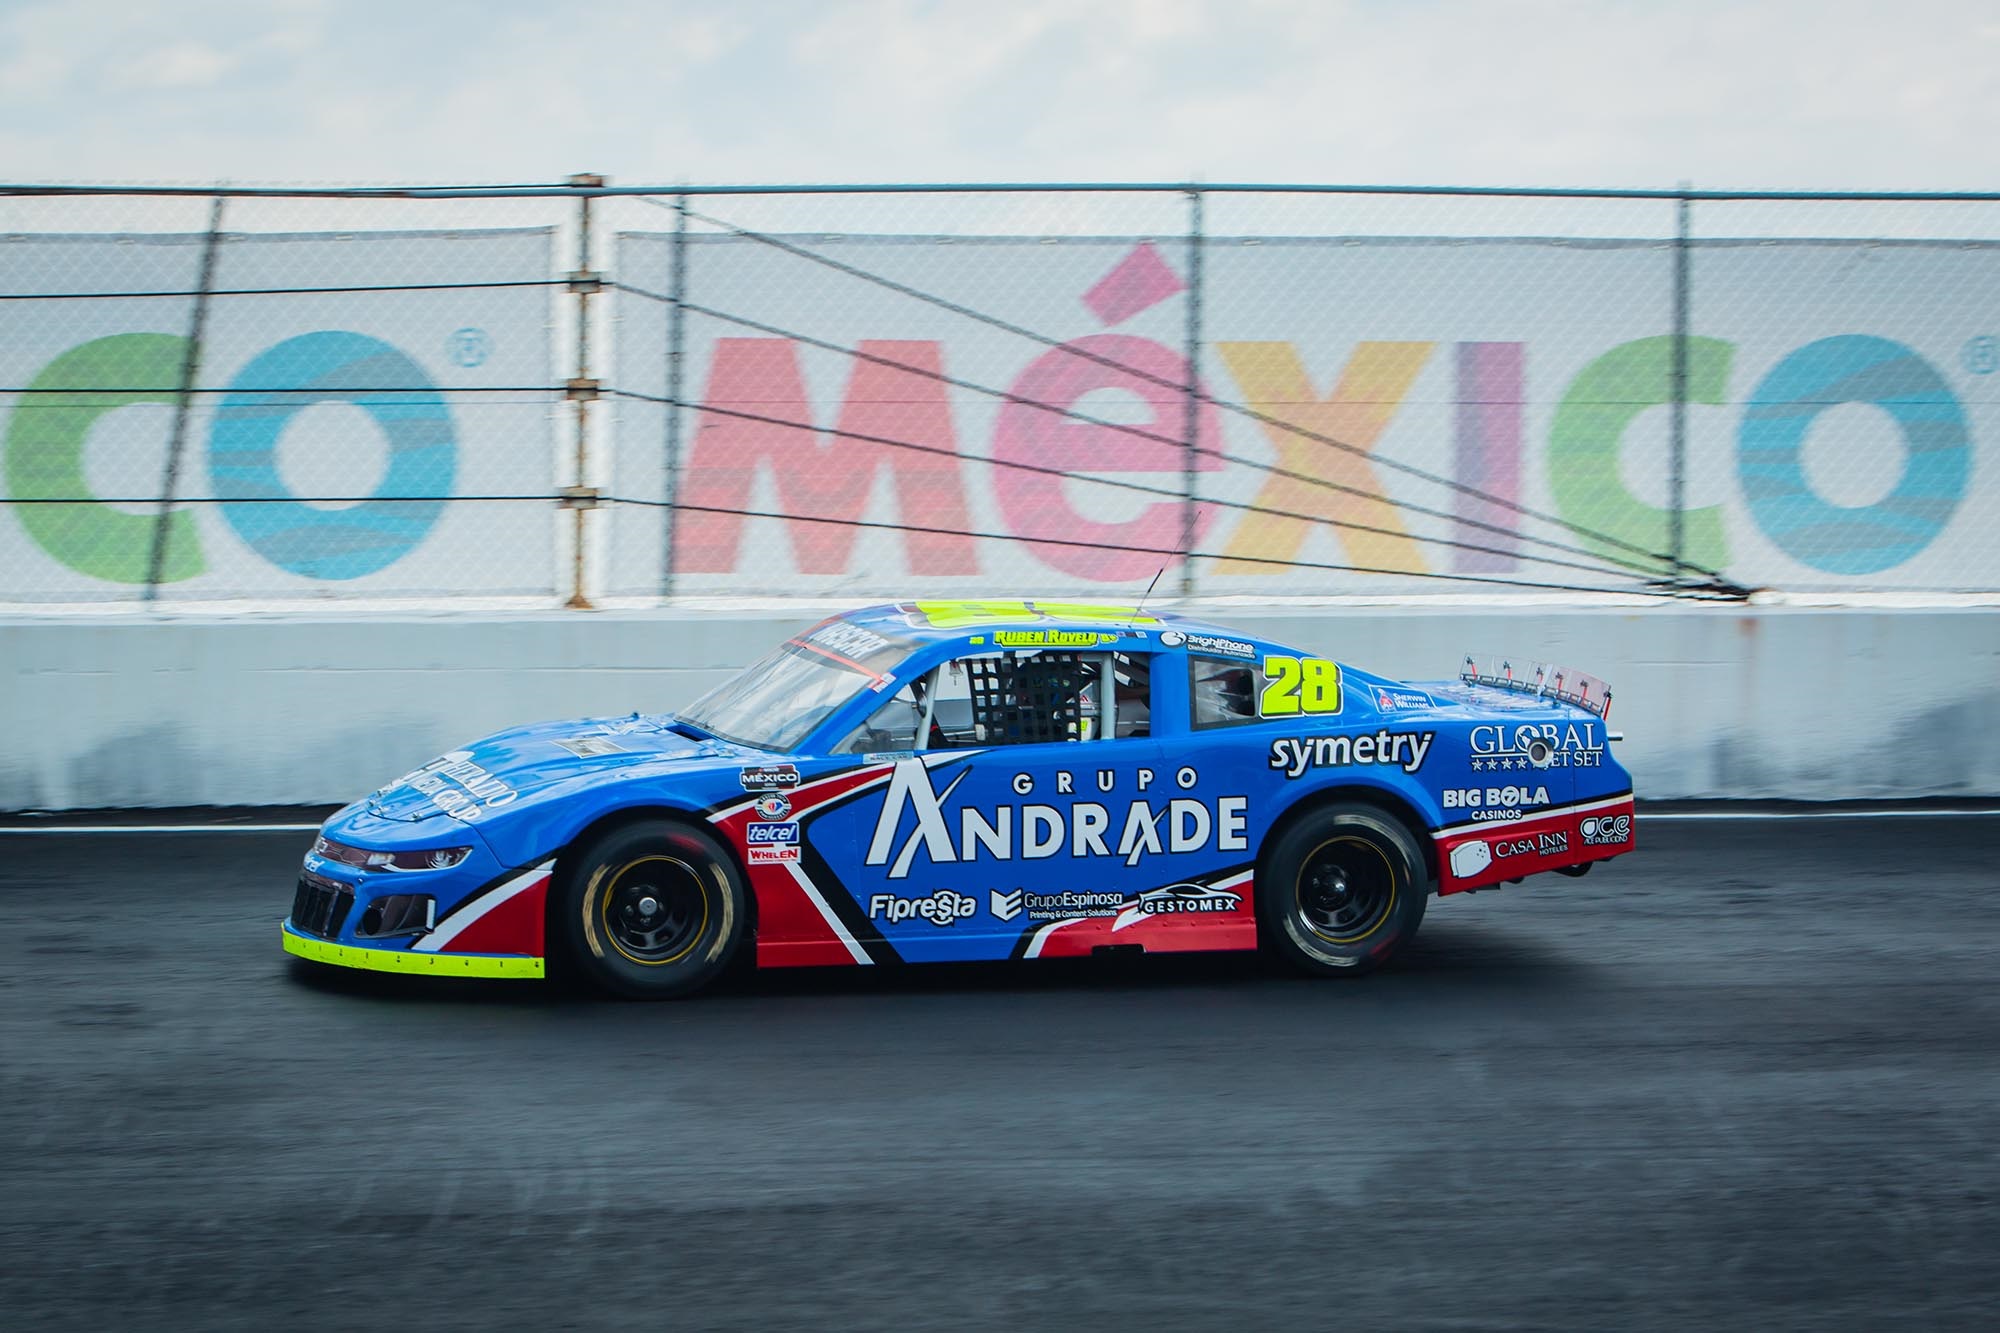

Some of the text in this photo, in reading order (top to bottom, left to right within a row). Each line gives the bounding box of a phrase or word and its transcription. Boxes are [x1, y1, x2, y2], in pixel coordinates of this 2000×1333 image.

[1261, 656, 1342, 716] 28
[1470, 723, 1604, 753] GLOBAL
[1272, 731, 1432, 777] symetry
[1574, 751, 1603, 766] SET
[742, 772, 797, 782] MÉXICO
[1013, 767, 1198, 795] GRUPO
[1443, 786, 1550, 808] BIG BOLA
[866, 758, 1248, 879] ANDRADE
[1472, 809, 1522, 821] CASINOS
[750, 825, 796, 841] telcel
[750, 849, 798, 859] WHELEN
[1495, 831, 1568, 858] CASA INN
[1539, 844, 1569, 856] HOTELES
[1144, 898, 1236, 913] GESTOMEX
